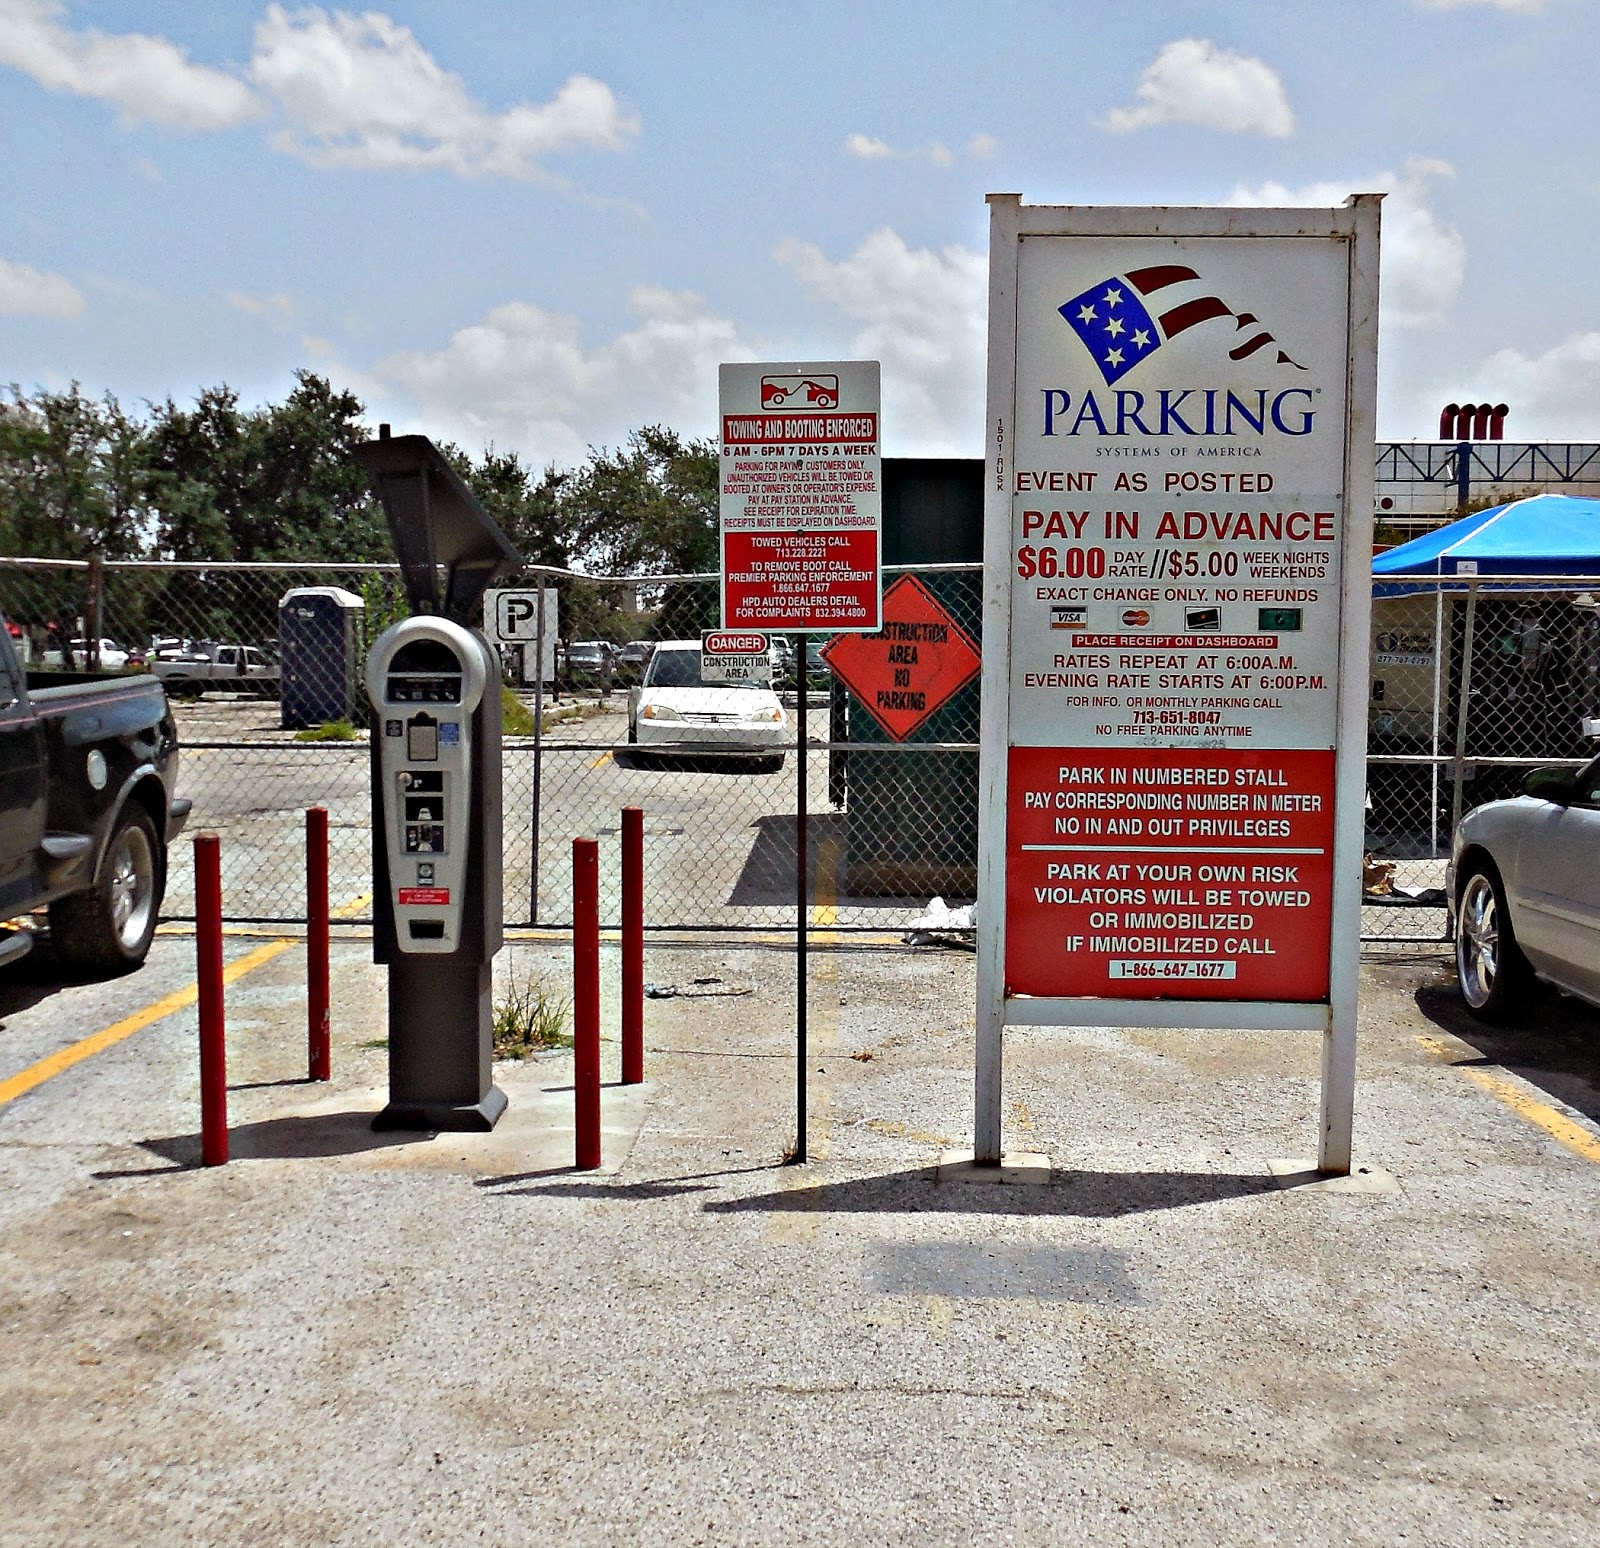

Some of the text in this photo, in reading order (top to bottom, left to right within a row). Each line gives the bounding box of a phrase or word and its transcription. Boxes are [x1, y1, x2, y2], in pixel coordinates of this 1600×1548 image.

[1040, 388, 1317, 436] PARKING
[728, 418, 873, 439] TOWING AND BOOTING ENFORCED
[734, 446, 750, 456] AM
[761, 446, 784, 456] 6PM
[789, 446, 795, 456] 7
[799, 446, 828, 456] DAYS
[832, 446, 839, 455] A
[843, 445, 876, 455] WEEK
[1096, 447, 1261, 456] SYSTEMS OF AMERICA
[735, 462, 763, 471] PARKING
[765, 462, 778, 470] FOR
[806, 461, 846, 470] CUSTOMERS
[727, 472, 873, 482] UNAUTHORIZED VEHICLES WILL BE TOWED OR
[1016, 471, 1274, 493] EVENT AS POSTED
[724, 483, 877, 494] BOOTED AT OWNER'S OR OPERATOR'S EXPENSE.
[749, 494, 853, 505] PAY AT PAY STATION IN ADVANCE.
[744, 507, 756, 516] SEE
[758, 506, 785, 516] RECEIPT
[787, 506, 800, 515] FOR
[802, 506, 839, 515] EXPIRATION
[725, 518, 755, 528] RECEIPTS
[757, 518, 775, 527] MUST
[777, 518, 785, 527] BE
[787, 517, 822, 527] DISPLAYED
[823, 517, 833, 526] ON
[1022, 510, 1335, 541] PAY IN ADVANCE
[751, 536, 850, 547] TOWED VEHICLES CALL
[776, 548, 826, 558] 713.228.2221
[1114, 552, 1145, 564] DAY
[1243, 552, 1329, 565] WEEK NIGHTS
[751, 561, 851, 572] TO REMOVE BOOT CALL
[1017, 545, 1106, 580] $6.00
[729, 572, 873, 582] PREMIER PARKING ENFORCEMENT
[1109, 565, 1148, 578] RATE
[1250, 566, 1326, 578] WEEKENDS
[772, 583, 830, 593] 1.866.647.1677
[1036, 588, 1318, 602] EXACT CHANGE ONLY. NO REFUNDS
[743, 596, 860, 607] HPD AUTO DEALERS DETAIL
[736, 607, 866, 618] FOR COMPLAINTS 832.394.4800
[1058, 613, 1081, 622] VISA
[711, 637, 761, 650] DANGER
[1076, 636, 1274, 648] PLACE RECEIPT ON DASHBOARD
[888, 645, 918, 665] AREA
[703, 656, 769, 667] CONSTRUCTION
[1053, 655, 1298, 670] RATES REPEAT AT 6:00A.M.
[725, 668, 748, 678] AREA
[894, 669, 910, 687] NO
[1025, 674, 1328, 690] EVENING RATE STARTS AT 6:00P.M.
[877, 691, 926, 711] PARKING
[1067, 697, 1282, 709] FOR INFO. OR MONTHLY PARKING CALL
[1133, 711, 1221, 725] 713-651-8047
[1096, 725, 1252, 737] NO FREE PARKING ANYTIME
[1059, 767, 1288, 786] PARK IN NUMBERED STALL
[1025, 792, 1321, 812] PAY CORRESPONDING NUMBER IN METER
[1055, 818, 1290, 837] NO IN AND OUT PRIVILEGES
[1048, 864, 1298, 883] PARK AT YOUR OWN RISK
[1034, 888, 1311, 907] VIOLATORS WILL BE TOWED
[1089, 913, 1253, 930] OR IMMOBILIZED
[1067, 936, 1276, 954] IF IMMOBILIZED CALL
[1121, 963, 1225, 977] 1-866-647-1677
